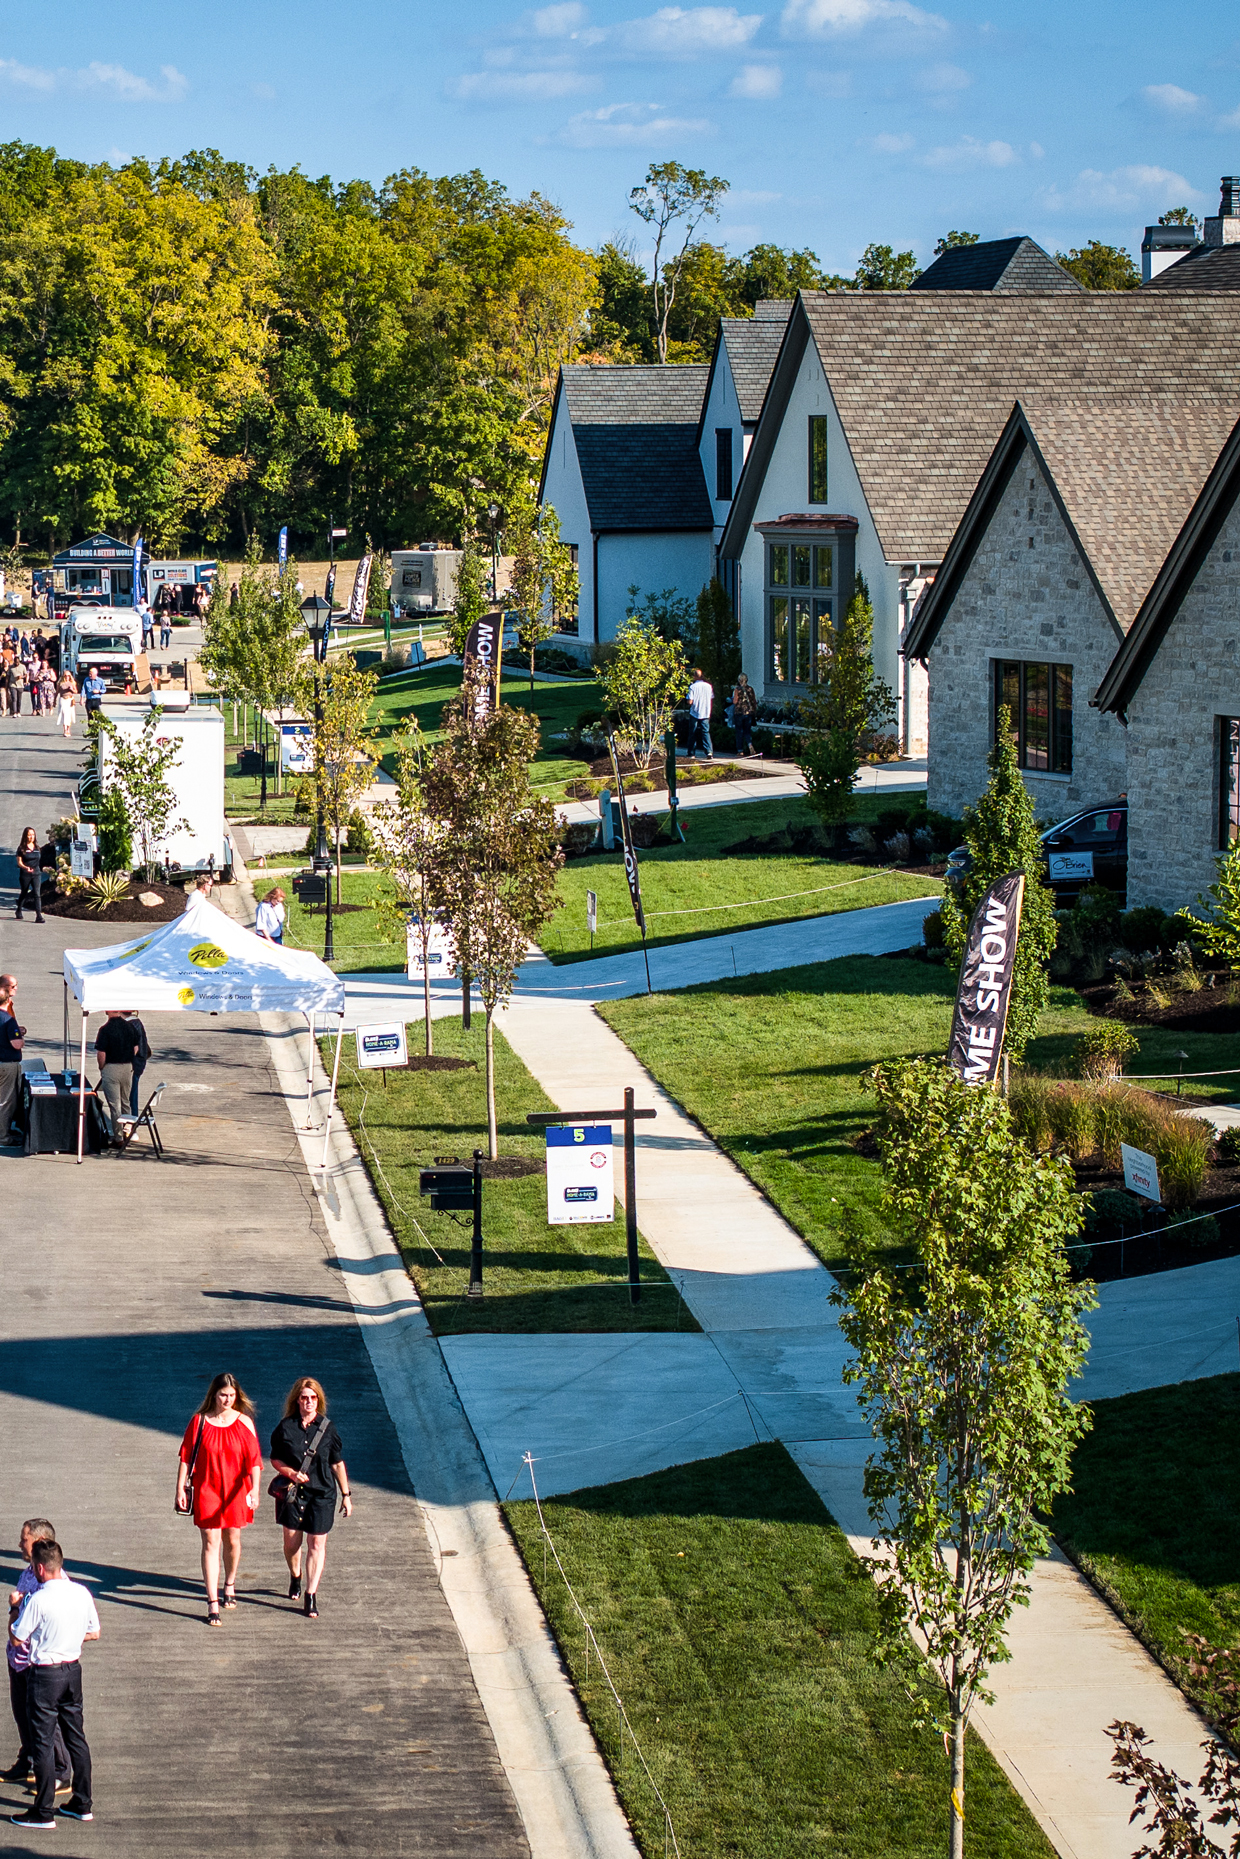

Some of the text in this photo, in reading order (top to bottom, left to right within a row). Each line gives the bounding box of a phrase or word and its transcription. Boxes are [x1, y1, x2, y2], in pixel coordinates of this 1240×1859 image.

[190, 949, 224, 963] Pella
[976, 896, 1007, 1012] SHOW
[573, 1128, 585, 1142] 5
[1132, 1173, 1150, 1188] xfinity
